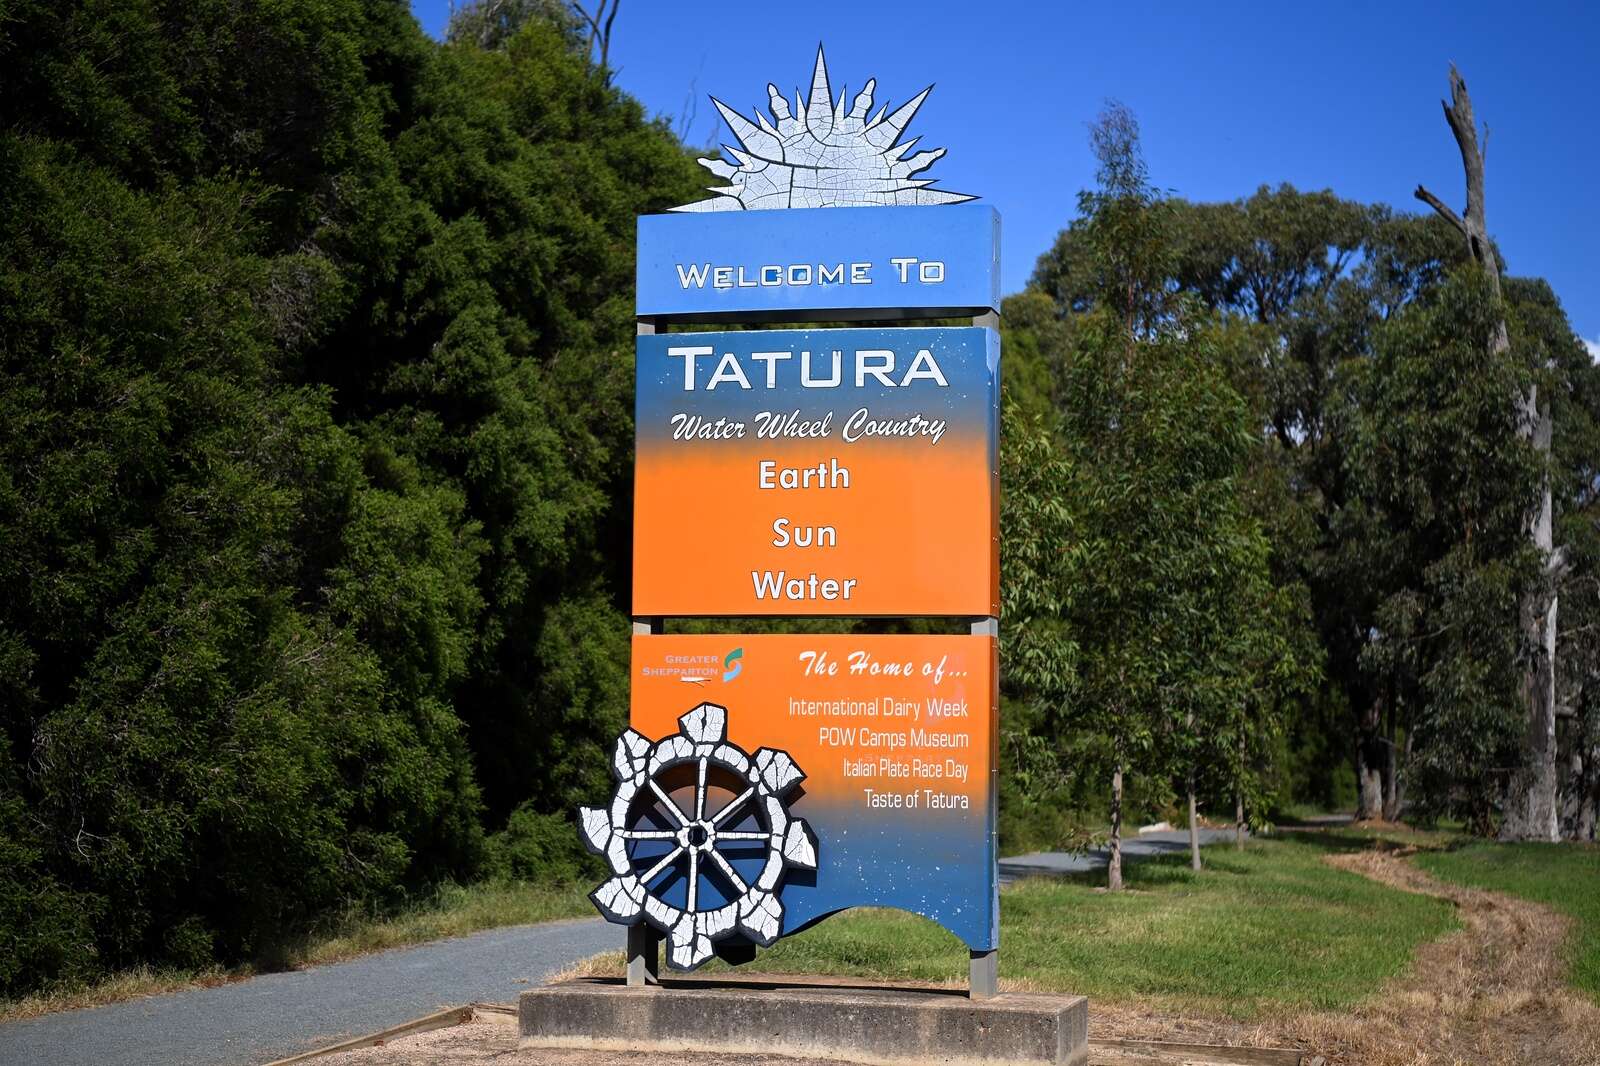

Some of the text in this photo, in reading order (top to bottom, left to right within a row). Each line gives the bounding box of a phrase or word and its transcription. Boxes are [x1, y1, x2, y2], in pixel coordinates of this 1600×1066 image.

[675, 257, 946, 289] WELCOME TO
[667, 346, 950, 391] TATURA
[670, 407, 947, 445] Water Wheel Country
[758, 458, 851, 489] Earth
[772, 517, 837, 547] Sun
[751, 570, 858, 600] Water
[799, 650, 839, 676] The
[847, 650, 914, 676] Home
[789, 696, 968, 721] International Dairy Week
[819, 727, 969, 750] POW Camps Museum
[843, 758, 969, 783] Italian Plate Race Day
[864, 789, 969, 809] Taste of Tatura
